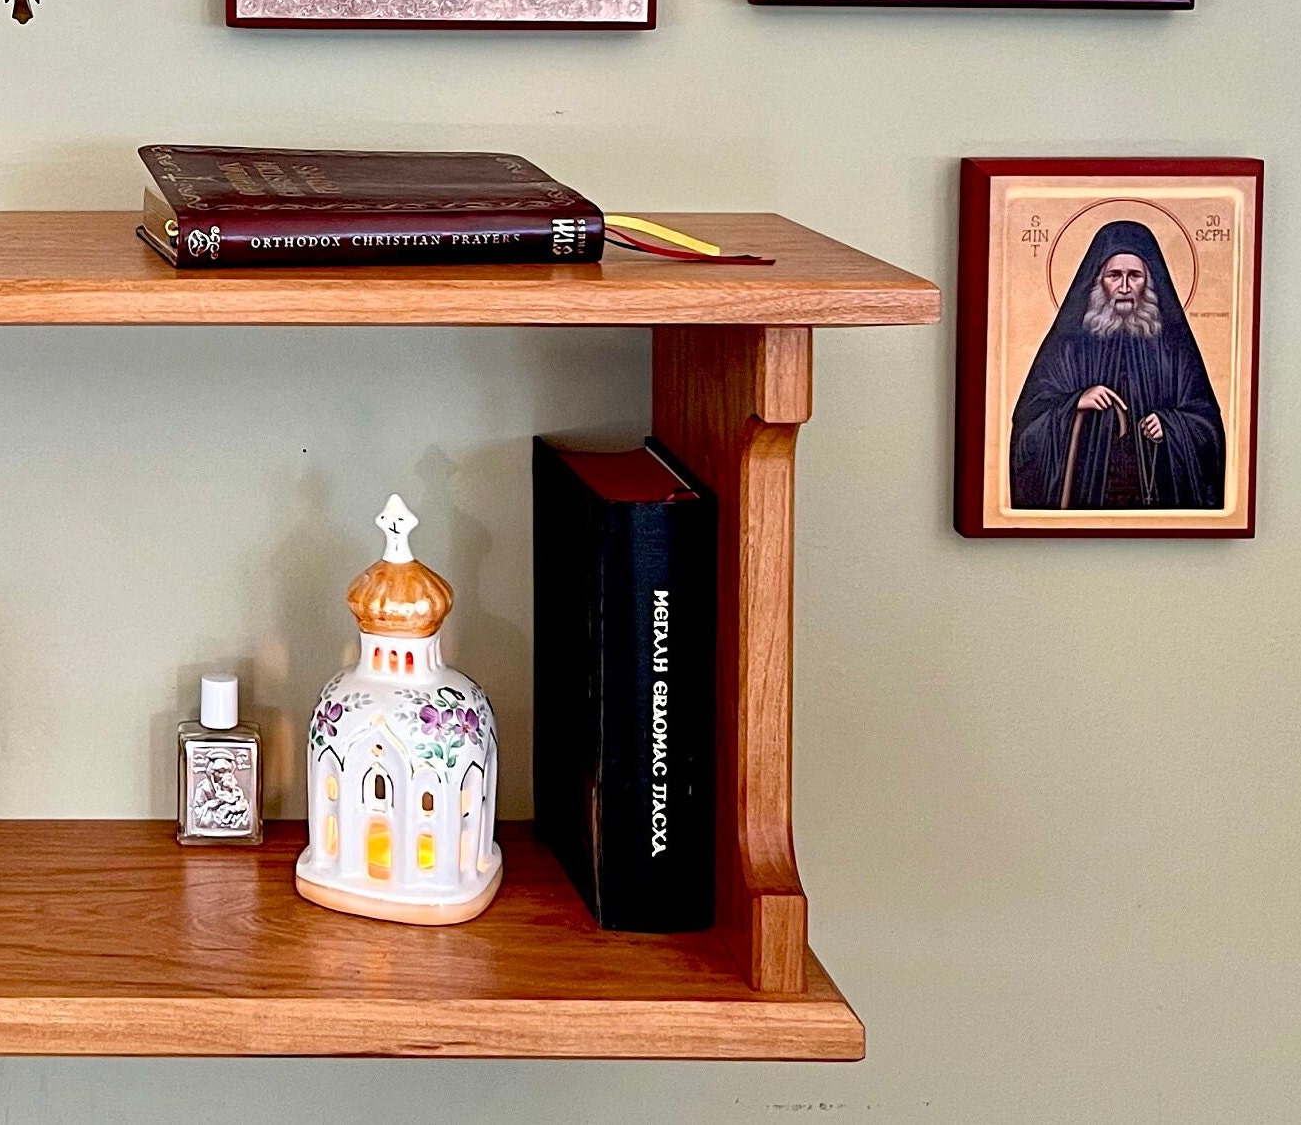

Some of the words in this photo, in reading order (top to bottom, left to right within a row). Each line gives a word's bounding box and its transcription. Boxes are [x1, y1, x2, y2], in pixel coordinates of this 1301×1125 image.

[250, 236, 341, 249] ORTHODOX
[351, 234, 442, 247] CHRISTIAN
[451, 233, 521, 245] PRAYERS
